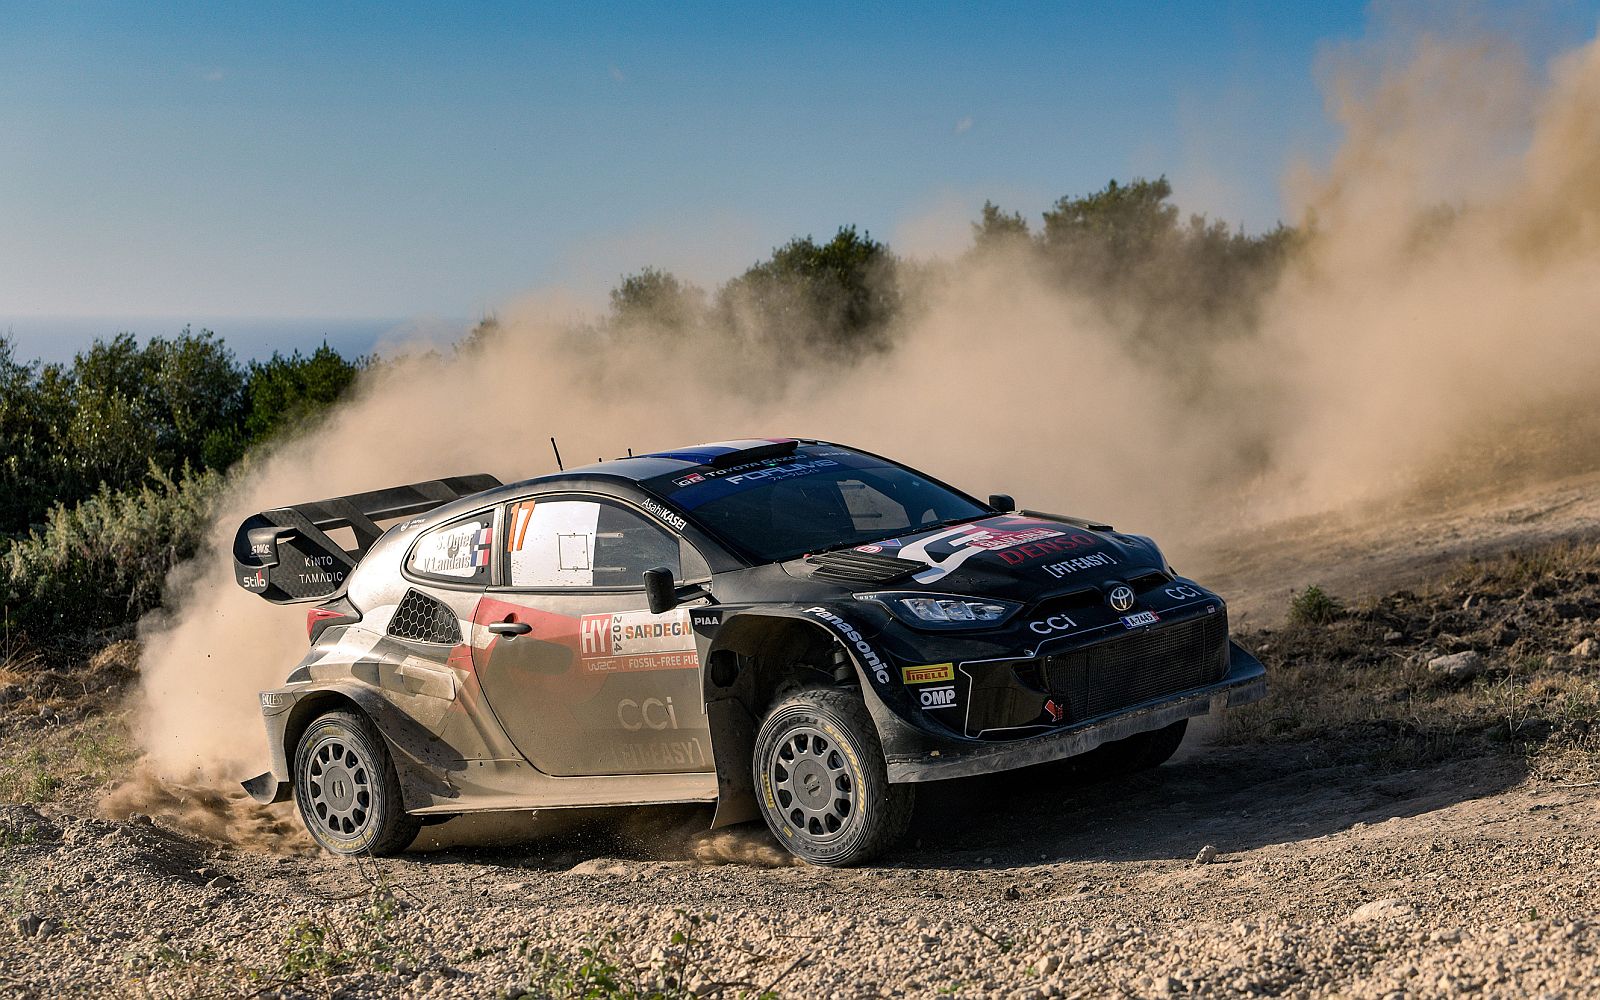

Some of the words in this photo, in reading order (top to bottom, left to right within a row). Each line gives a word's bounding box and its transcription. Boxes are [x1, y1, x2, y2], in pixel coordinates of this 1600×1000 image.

[704, 462, 760, 477] TOYOTA
[507, 500, 535, 552] 17
[997, 534, 1096, 565] DENSO
[299, 571, 343, 584] TAMADIC
[694, 616, 719, 625] PIAA
[581, 618, 609, 654] HY
[612, 616, 622, 652] 2024
[803, 606, 890, 684] Panasonic
[906, 666, 949, 681] PIRELLI
[920, 690, 956, 706] OMP
